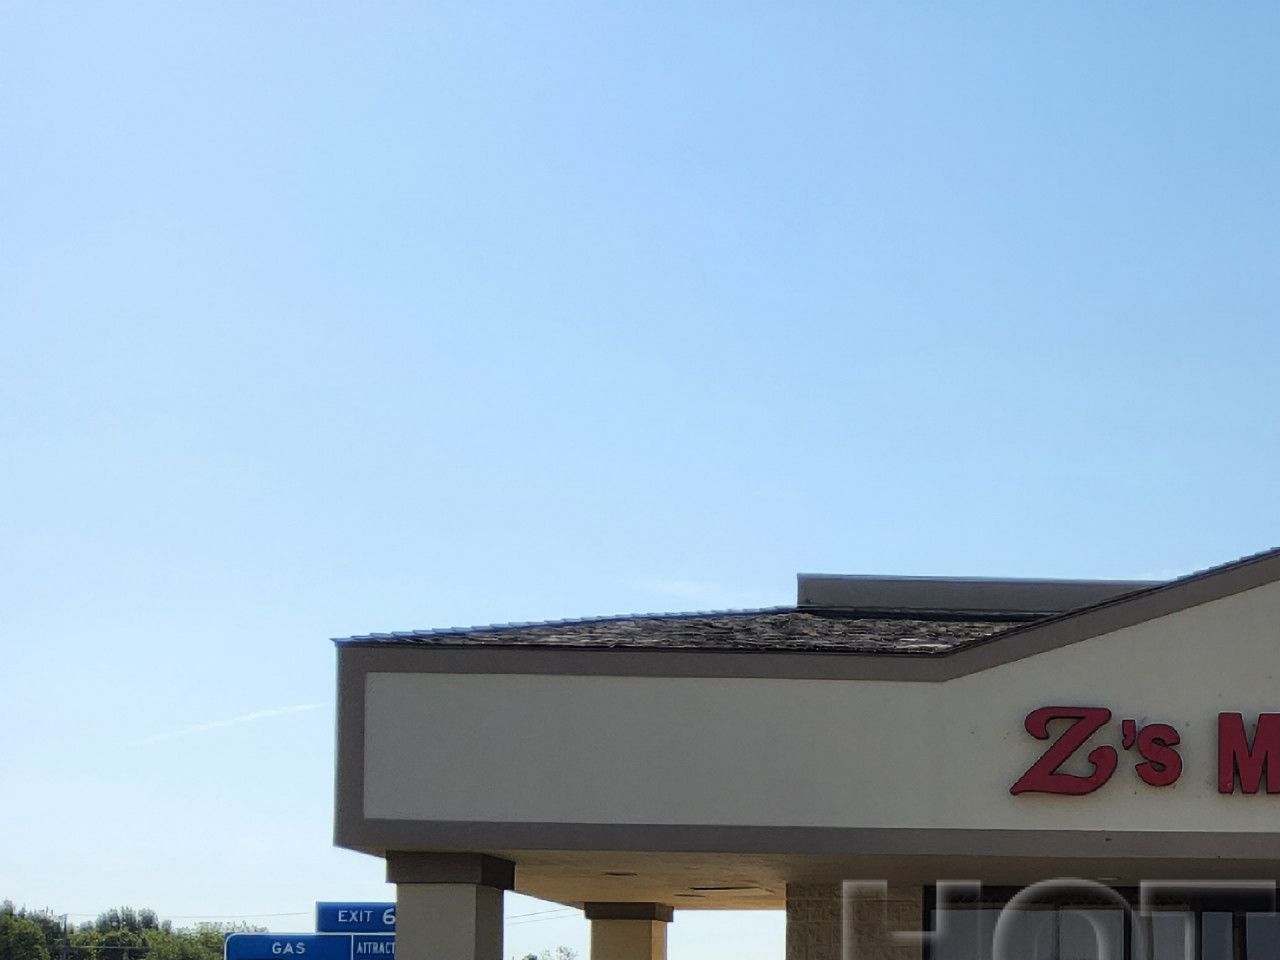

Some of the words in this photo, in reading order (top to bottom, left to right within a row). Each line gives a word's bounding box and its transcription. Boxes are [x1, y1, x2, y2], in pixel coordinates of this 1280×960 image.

[1010, 706, 1183, 796] Z's
[338, 909, 374, 922] EXIT
[272, 942, 306, 954] GAS
